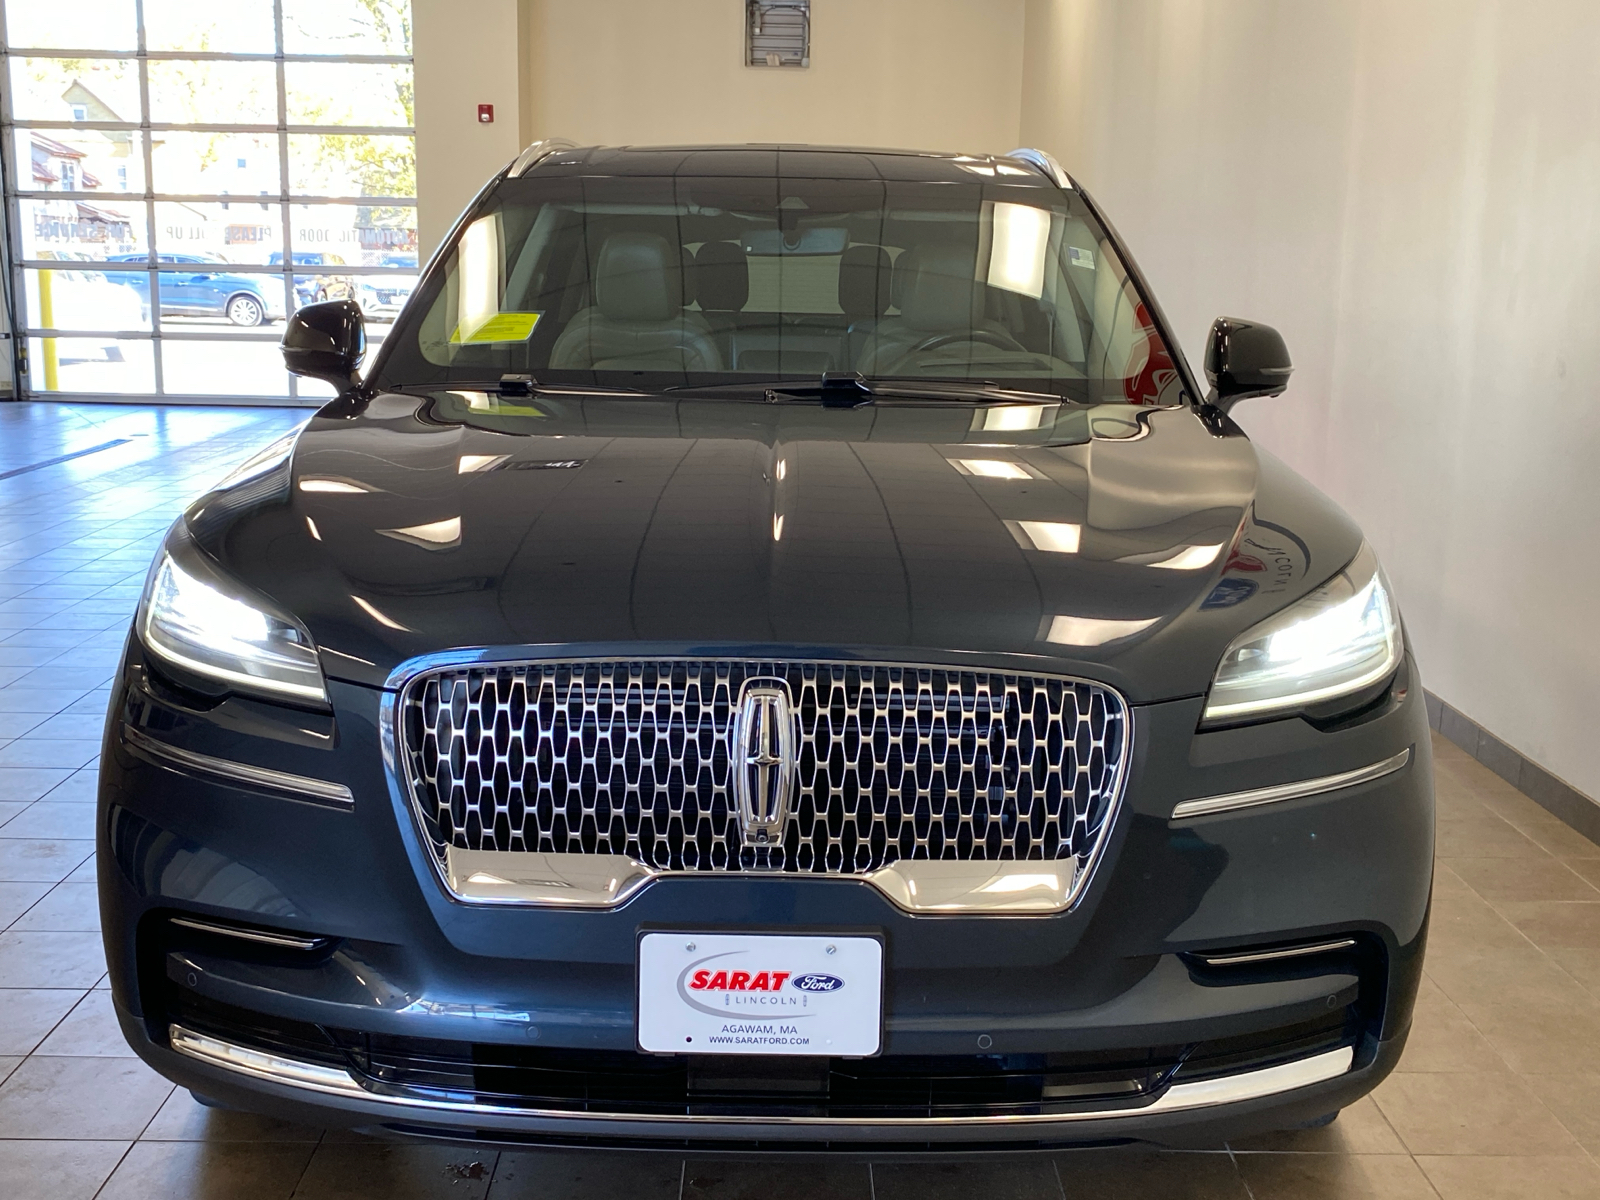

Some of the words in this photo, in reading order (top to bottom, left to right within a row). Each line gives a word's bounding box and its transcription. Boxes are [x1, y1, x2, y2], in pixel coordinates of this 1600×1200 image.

[688, 969, 792, 993] SARAT
[800, 975, 835, 991] Ford
[735, 996, 798, 1005] LINCOLN
[721, 1024, 777, 1035] AGAWAM,
[779, 1025, 798, 1035] MA
[708, 1035, 810, 1046] WWW.SARATFORD.COM
